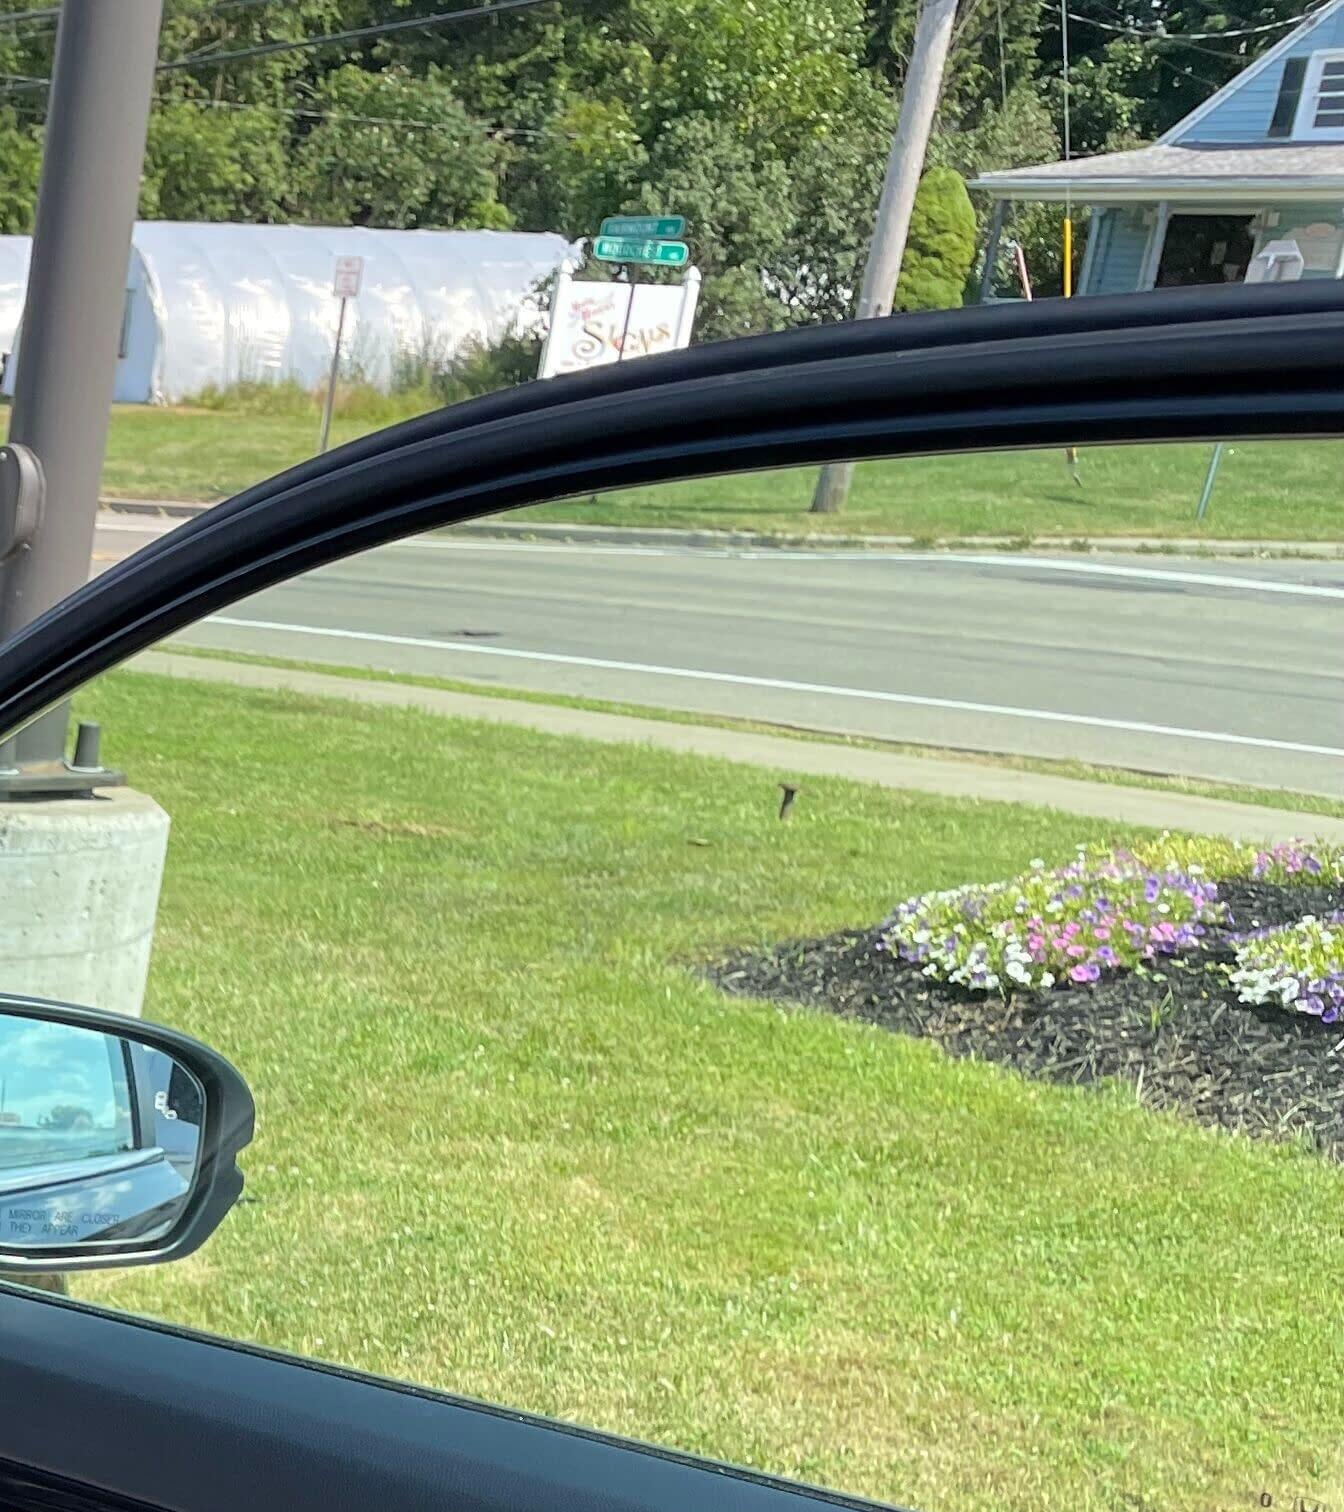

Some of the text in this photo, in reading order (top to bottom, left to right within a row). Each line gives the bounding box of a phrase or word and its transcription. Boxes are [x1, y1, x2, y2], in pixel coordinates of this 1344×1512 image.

[9, 1209, 47, 1220] MIRROR
[55, 1211, 73, 1223] ARE
[41, 1223, 79, 1236] APPEAR
